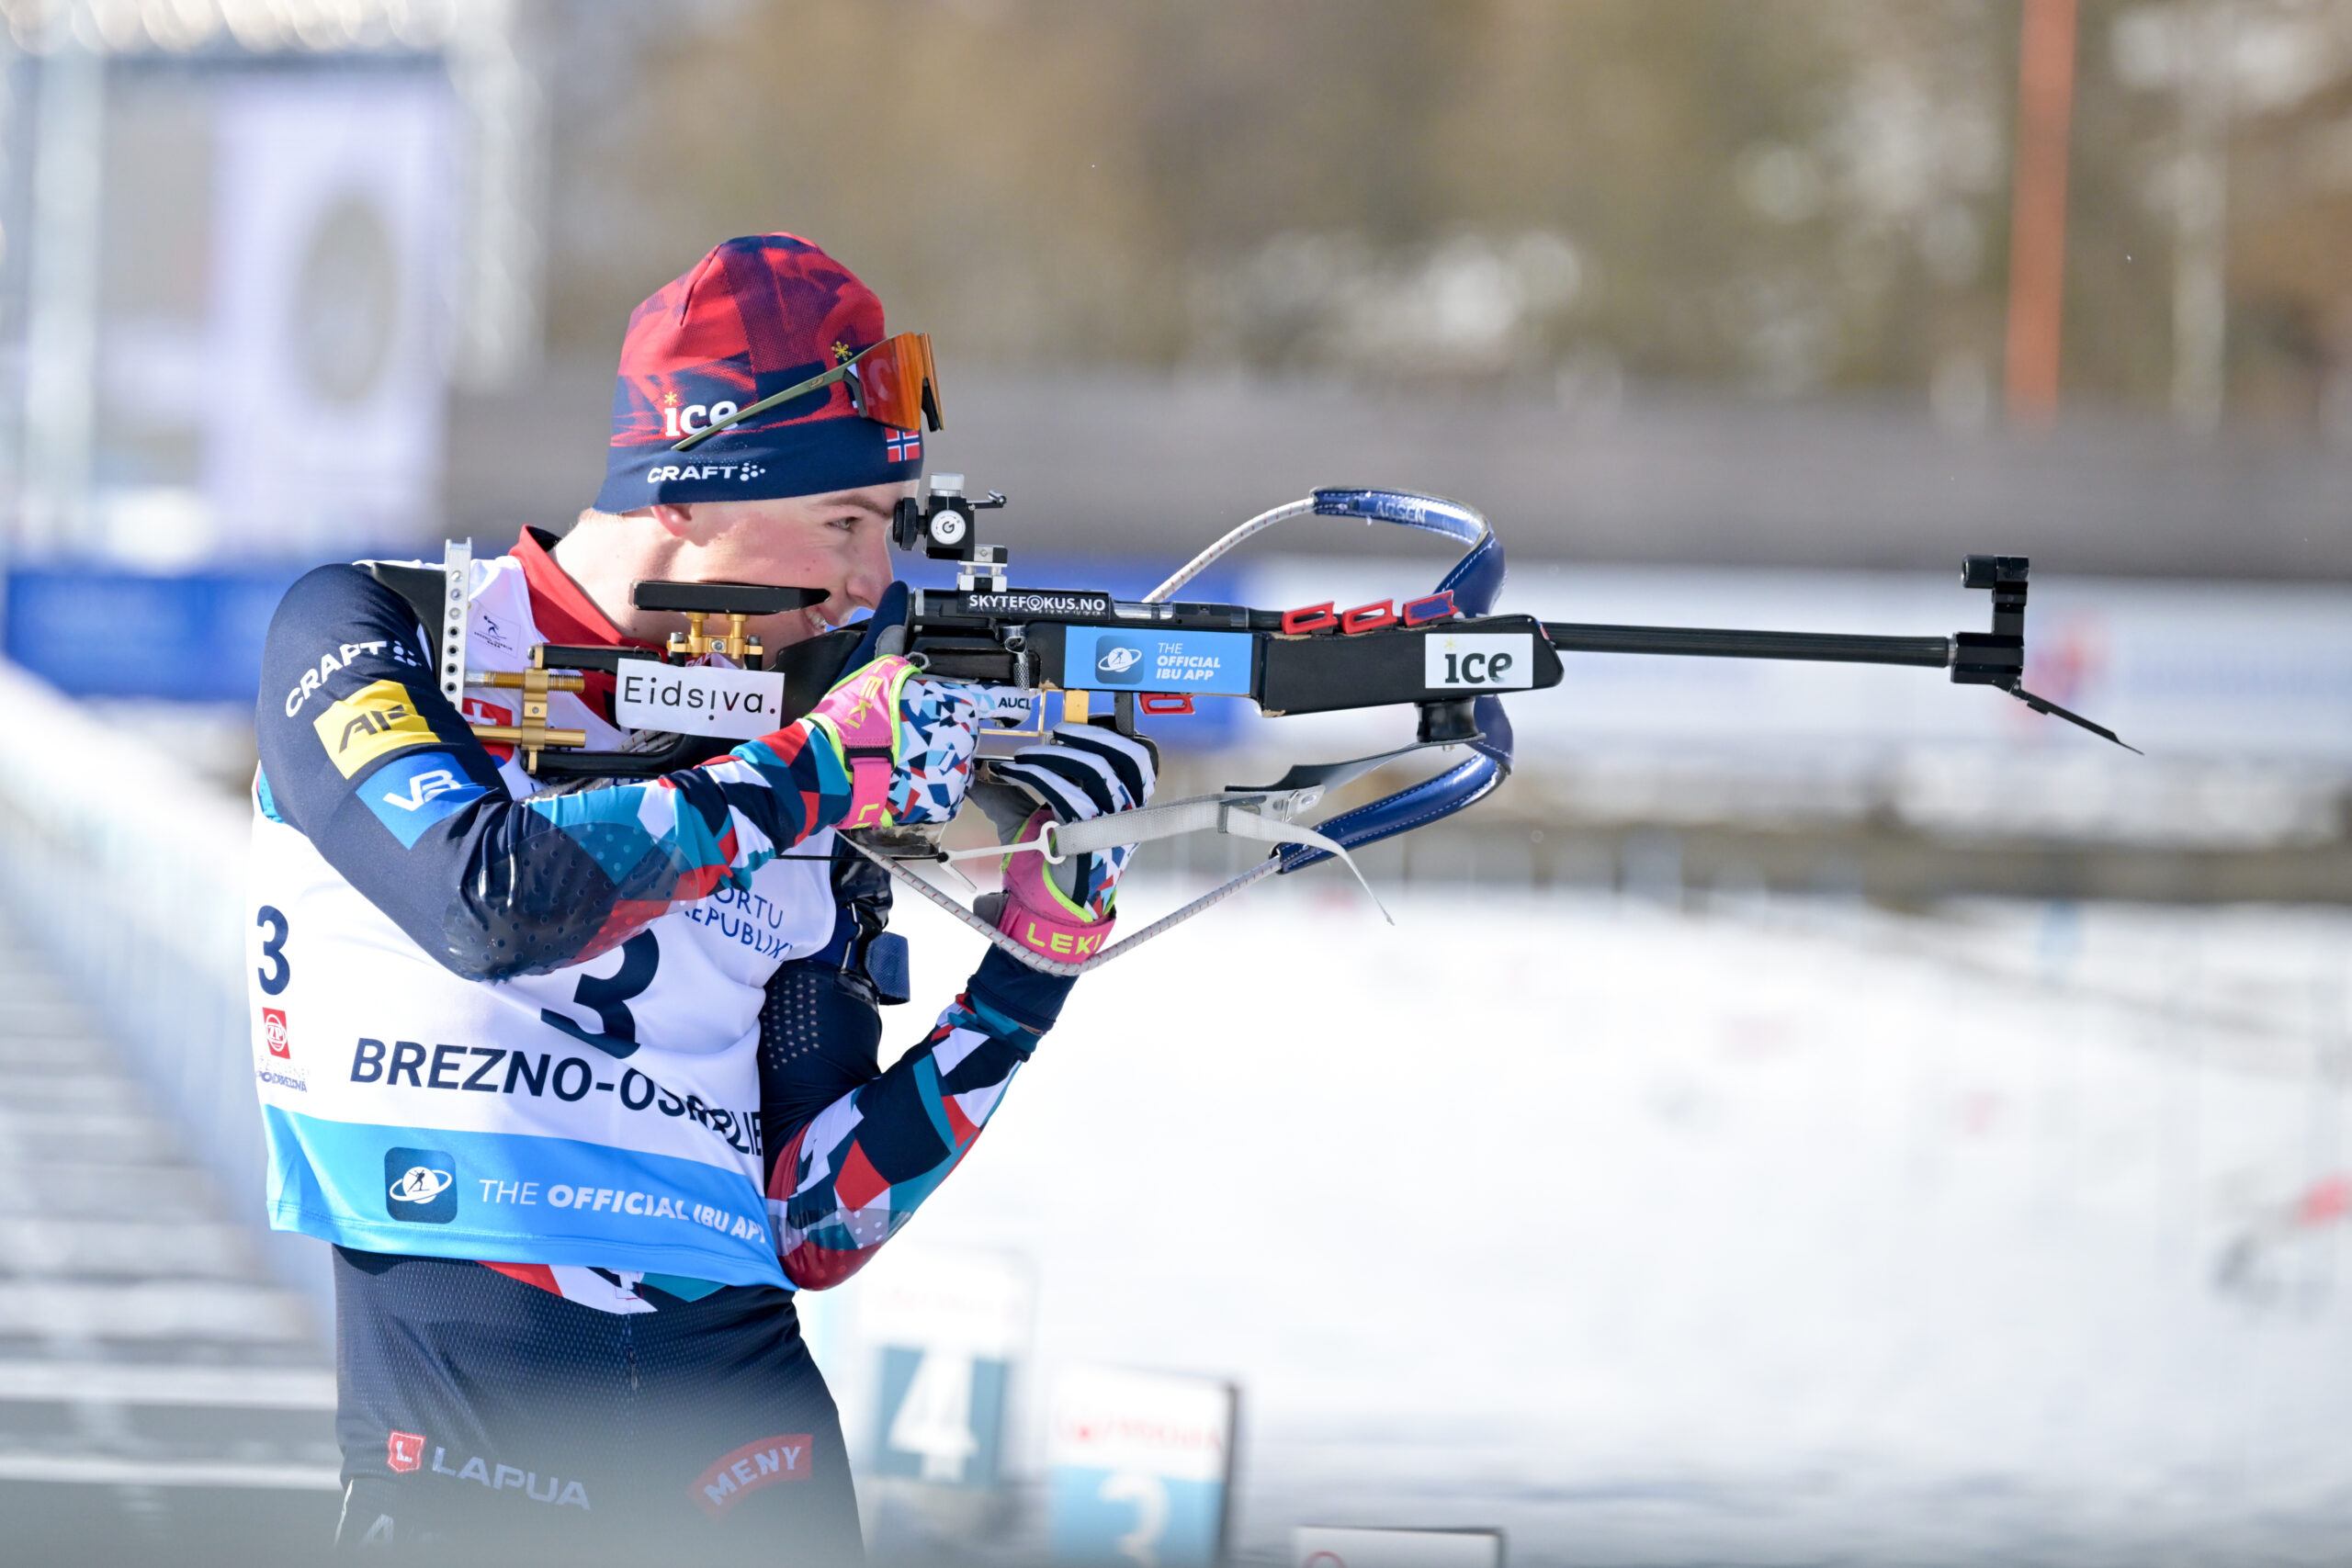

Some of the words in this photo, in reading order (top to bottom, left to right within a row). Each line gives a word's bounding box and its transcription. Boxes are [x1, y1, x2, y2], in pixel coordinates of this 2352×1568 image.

[664, 391, 739, 436] ice
[647, 466, 738, 483] CRAFT
[969, 594, 1105, 612] SKYTEFOKUS.NO
[1156, 655, 1221, 669] OFFICIAL
[1158, 642, 1183, 655] THE
[1444, 641, 1513, 684] ice
[286, 641, 388, 717] CRAFT
[845, 659, 899, 728] LEKI
[1156, 668, 1182, 680] IBU
[1183, 669, 1214, 681] APP
[714, 887, 784, 930] ORTU
[256, 905, 290, 996] 3
[684, 906, 793, 962] EPUBLIK
[1027, 922, 1102, 954] LEKI
[540, 928, 660, 1059] 3
[479, 1179, 538, 1205] THE
[547, 1184, 689, 1221] OFFICIAL
[693, 1203, 729, 1233] IBU
[888, 1350, 979, 1483] 4
[432, 1446, 591, 1510] LAPUA
[704, 1445, 802, 1506] MENY
